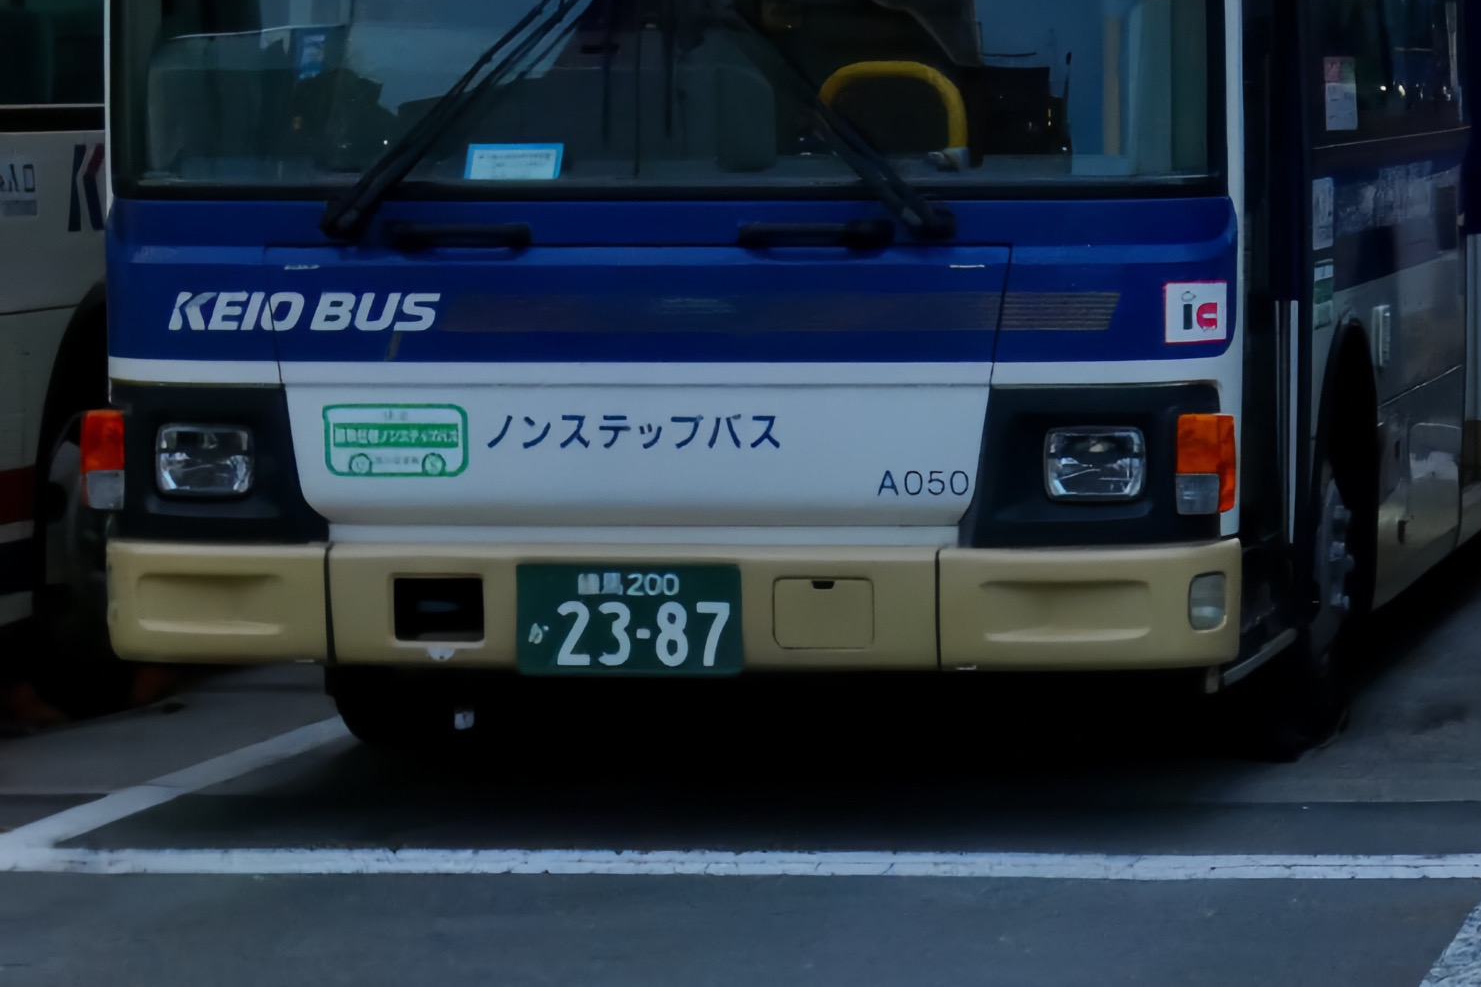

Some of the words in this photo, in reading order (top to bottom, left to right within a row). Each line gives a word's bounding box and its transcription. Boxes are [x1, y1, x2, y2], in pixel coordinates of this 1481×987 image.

[168, 291, 305, 331] KEIO
[310, 292, 441, 331] BUS
[877, 470, 969, 496] A050
[557, 600, 731, 667] 23-87
